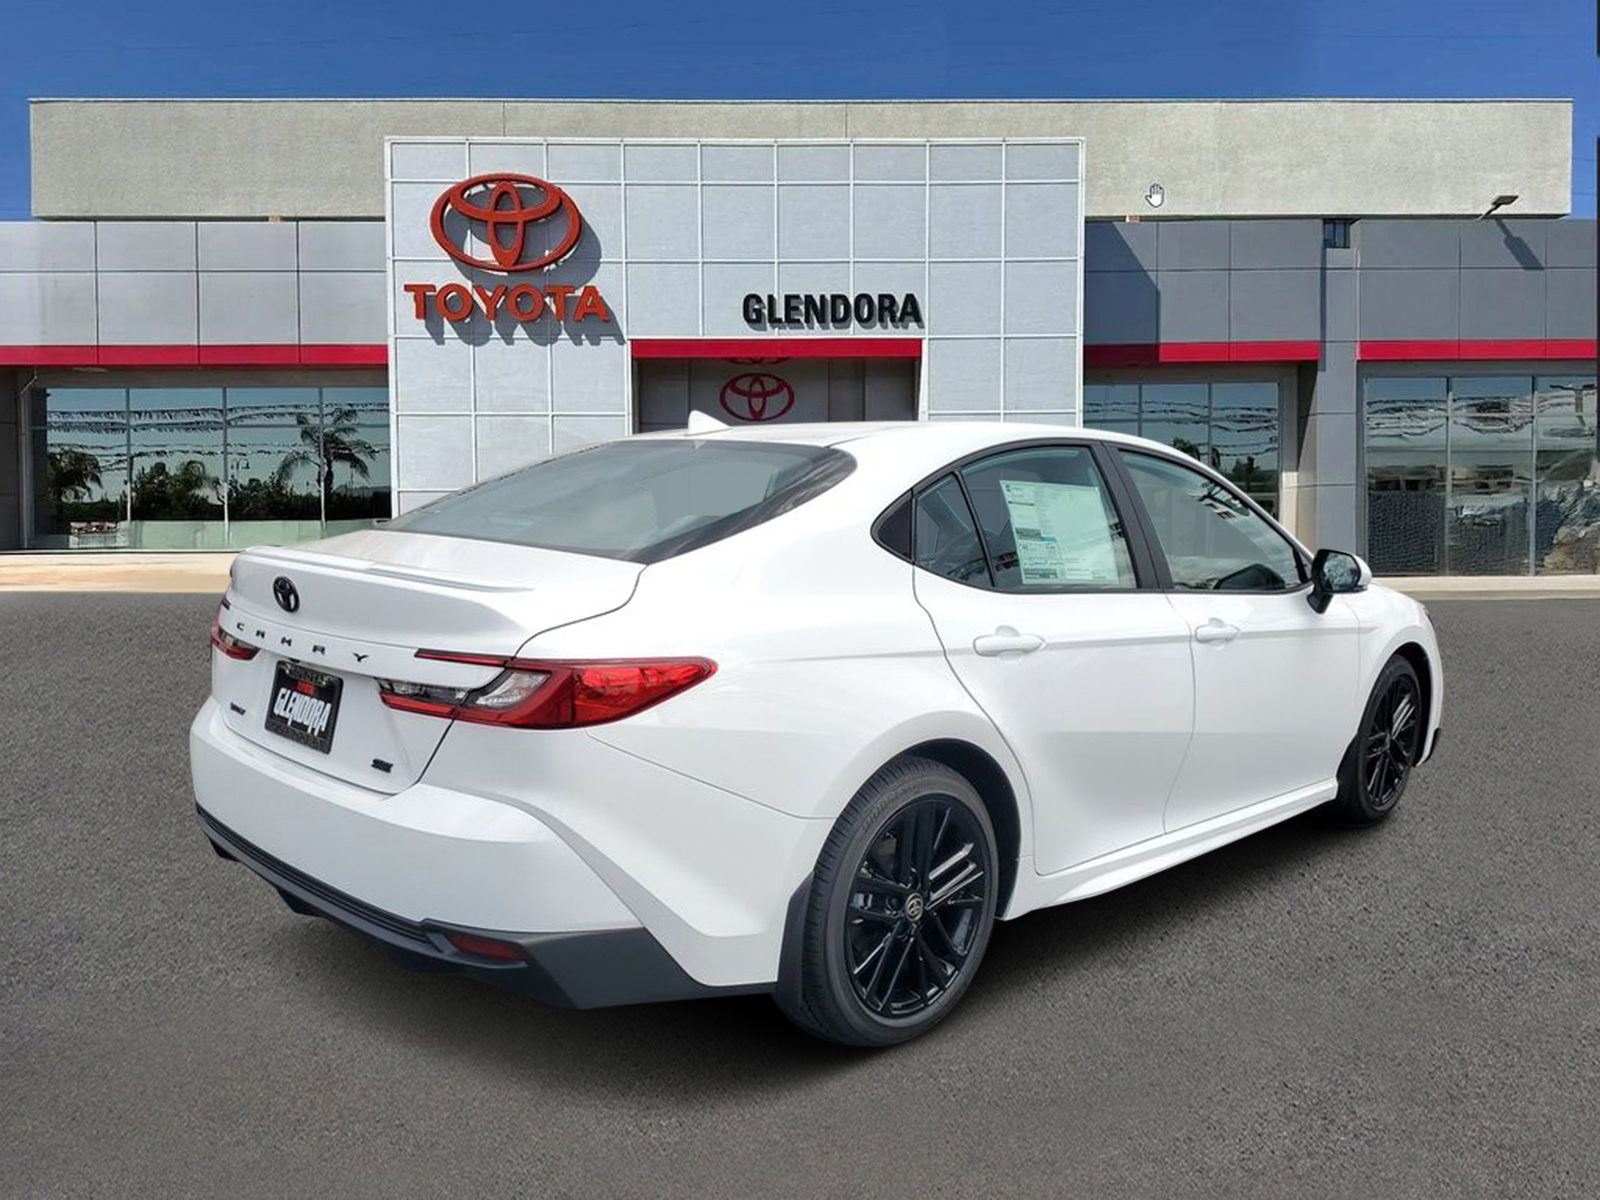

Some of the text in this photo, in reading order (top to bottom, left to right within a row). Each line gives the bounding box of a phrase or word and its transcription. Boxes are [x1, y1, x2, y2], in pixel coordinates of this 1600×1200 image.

[404, 283, 610, 322] TOYOTA
[743, 293, 923, 325] GLENDORA
[236, 622, 369, 662] CAMRY
[273, 687, 332, 737] GLENDORA
